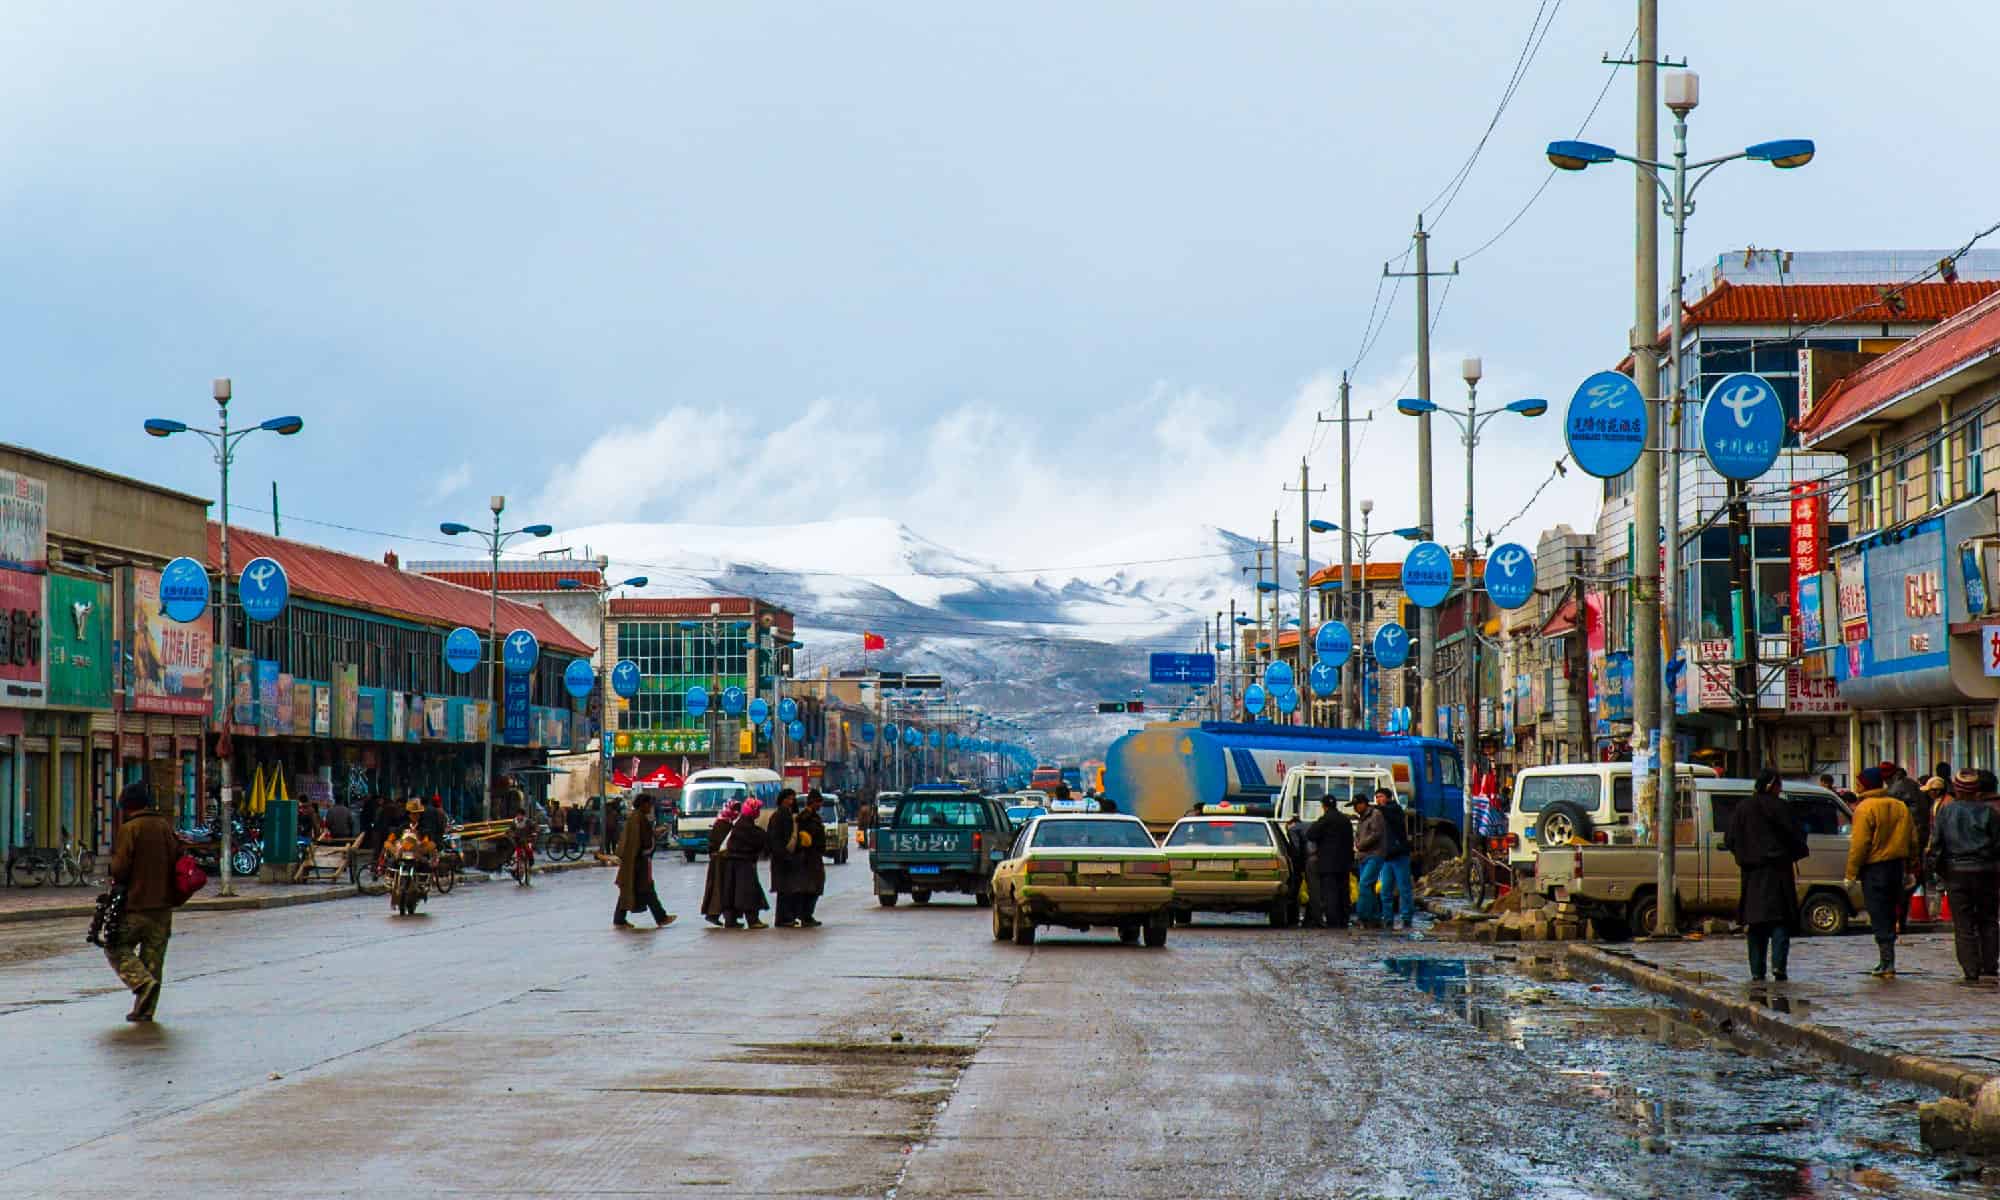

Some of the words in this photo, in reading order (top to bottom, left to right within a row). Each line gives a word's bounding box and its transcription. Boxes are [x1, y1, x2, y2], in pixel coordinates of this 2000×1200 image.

[1713, 437, 1769, 455] 中国电信
[1491, 583, 1527, 593] 中国电信
